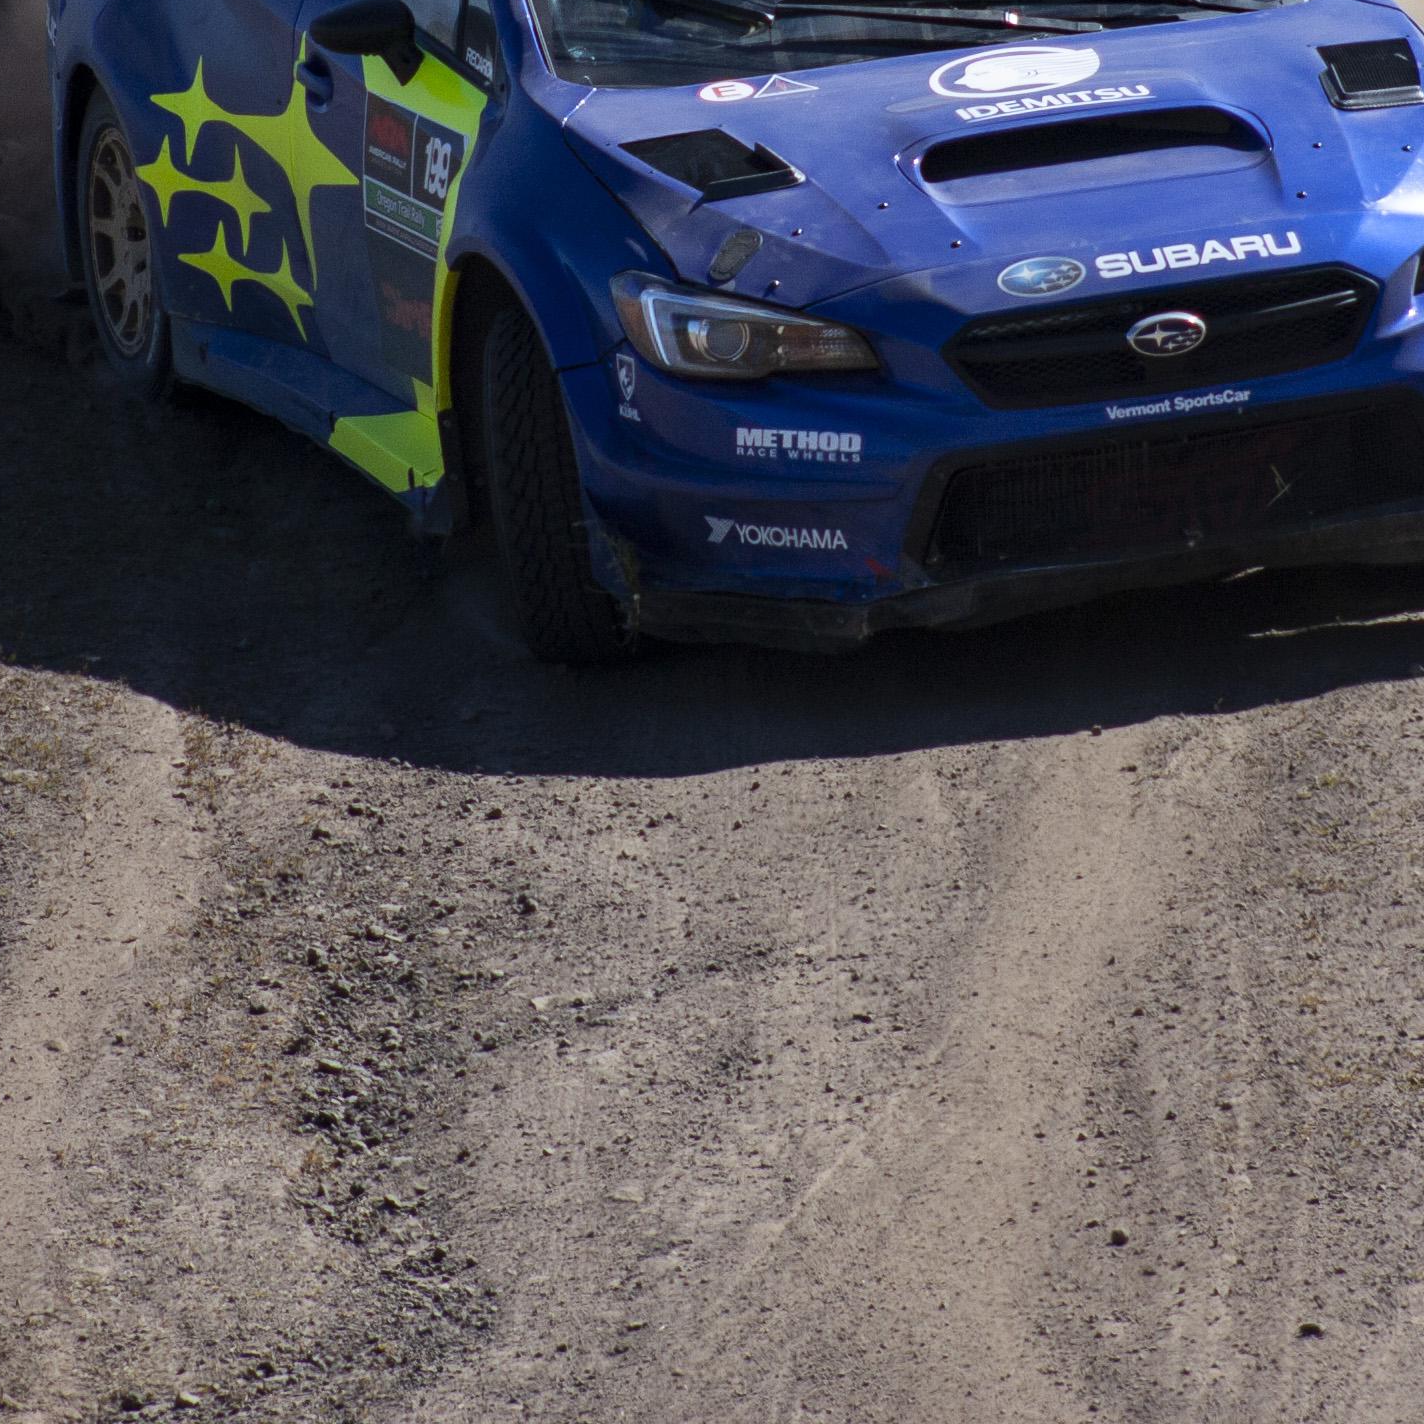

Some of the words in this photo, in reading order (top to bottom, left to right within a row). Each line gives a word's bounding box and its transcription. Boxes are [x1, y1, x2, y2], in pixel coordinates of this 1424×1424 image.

[711, 84, 742, 98] E
[955, 84, 1151, 121] IDEMITSU
[424, 136, 452, 199] 199
[1094, 231, 1302, 279] SUBARU
[1105, 400, 1171, 420] Vermont
[1174, 389, 1251, 412] SportsCar
[736, 427, 862, 453] METHOD
[736, 446, 778, 458] RACE
[787, 449, 861, 463] WHEELS
[734, 523, 849, 551] YOKOHAMA
